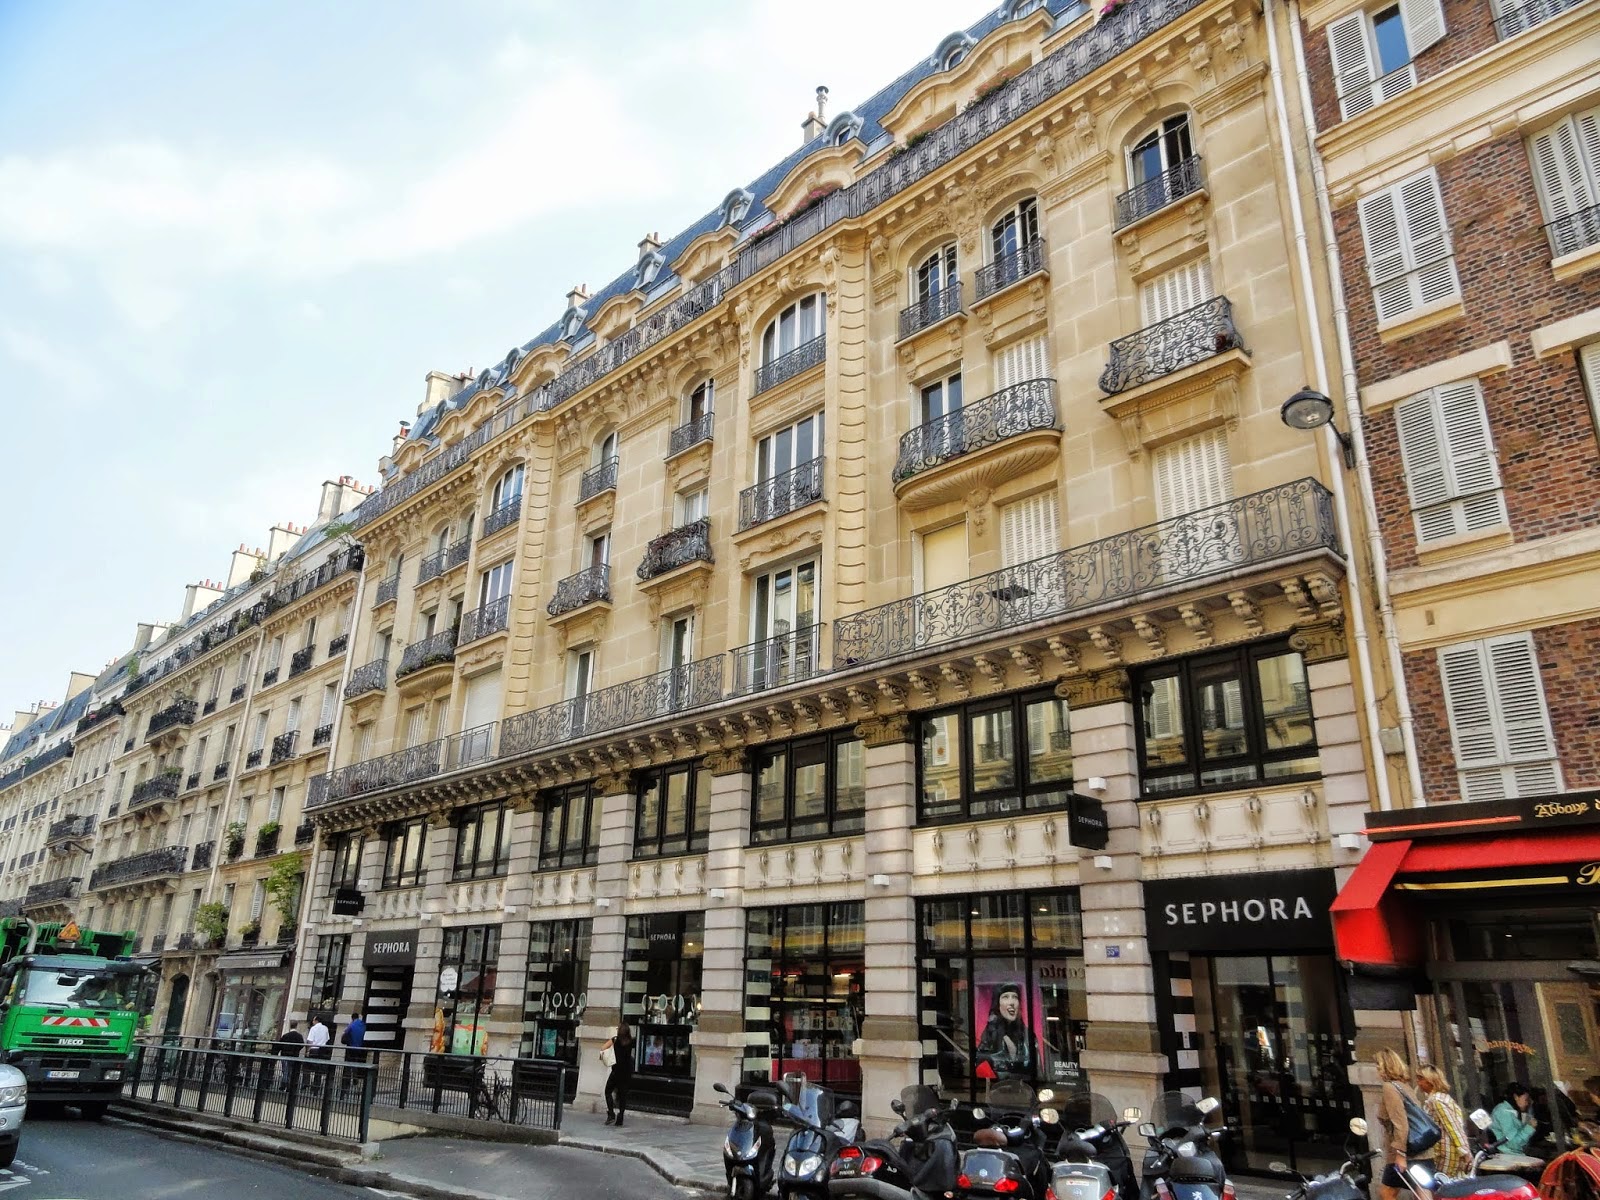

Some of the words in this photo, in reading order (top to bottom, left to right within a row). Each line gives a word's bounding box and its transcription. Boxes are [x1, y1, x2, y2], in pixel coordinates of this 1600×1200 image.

[1534, 802, 1589, 818] Abbaye
[1078, 816, 1102, 827] SEPHORA
[1165, 897, 1312, 925] SEPHORA
[373, 941, 410, 954] SEPHORA
[58, 1038, 84, 1046] IVECO
[1054, 1061, 1078, 1069] BEAUTY
